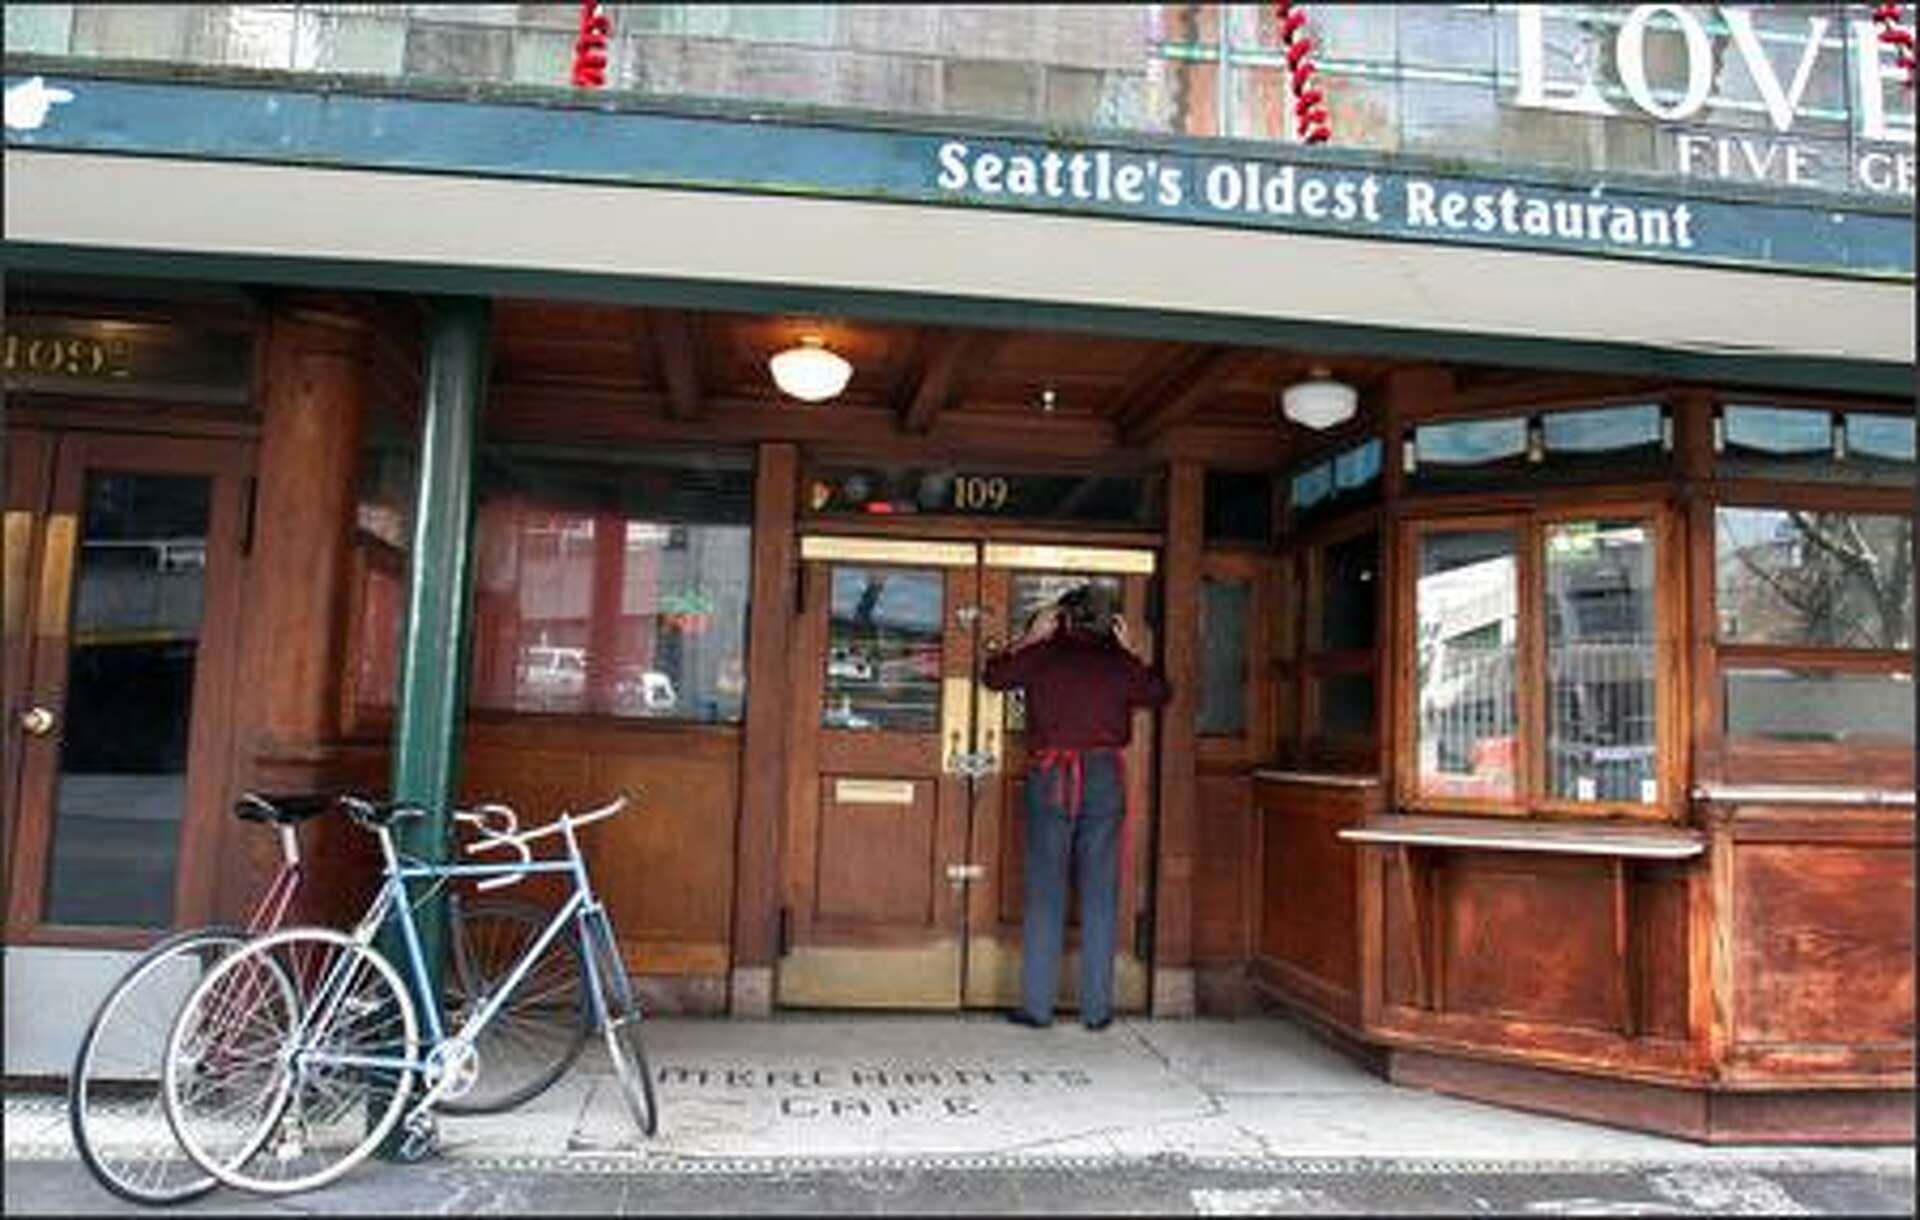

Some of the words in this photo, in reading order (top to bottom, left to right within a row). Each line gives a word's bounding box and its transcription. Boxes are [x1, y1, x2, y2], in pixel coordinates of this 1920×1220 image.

[1678, 134, 1822, 187] FIVE
[937, 141, 1182, 205] Seattle's
[1206, 162, 1381, 222] Oldest
[1406, 181, 1694, 247] Restaurant
[954, 477, 1008, 509] 109
